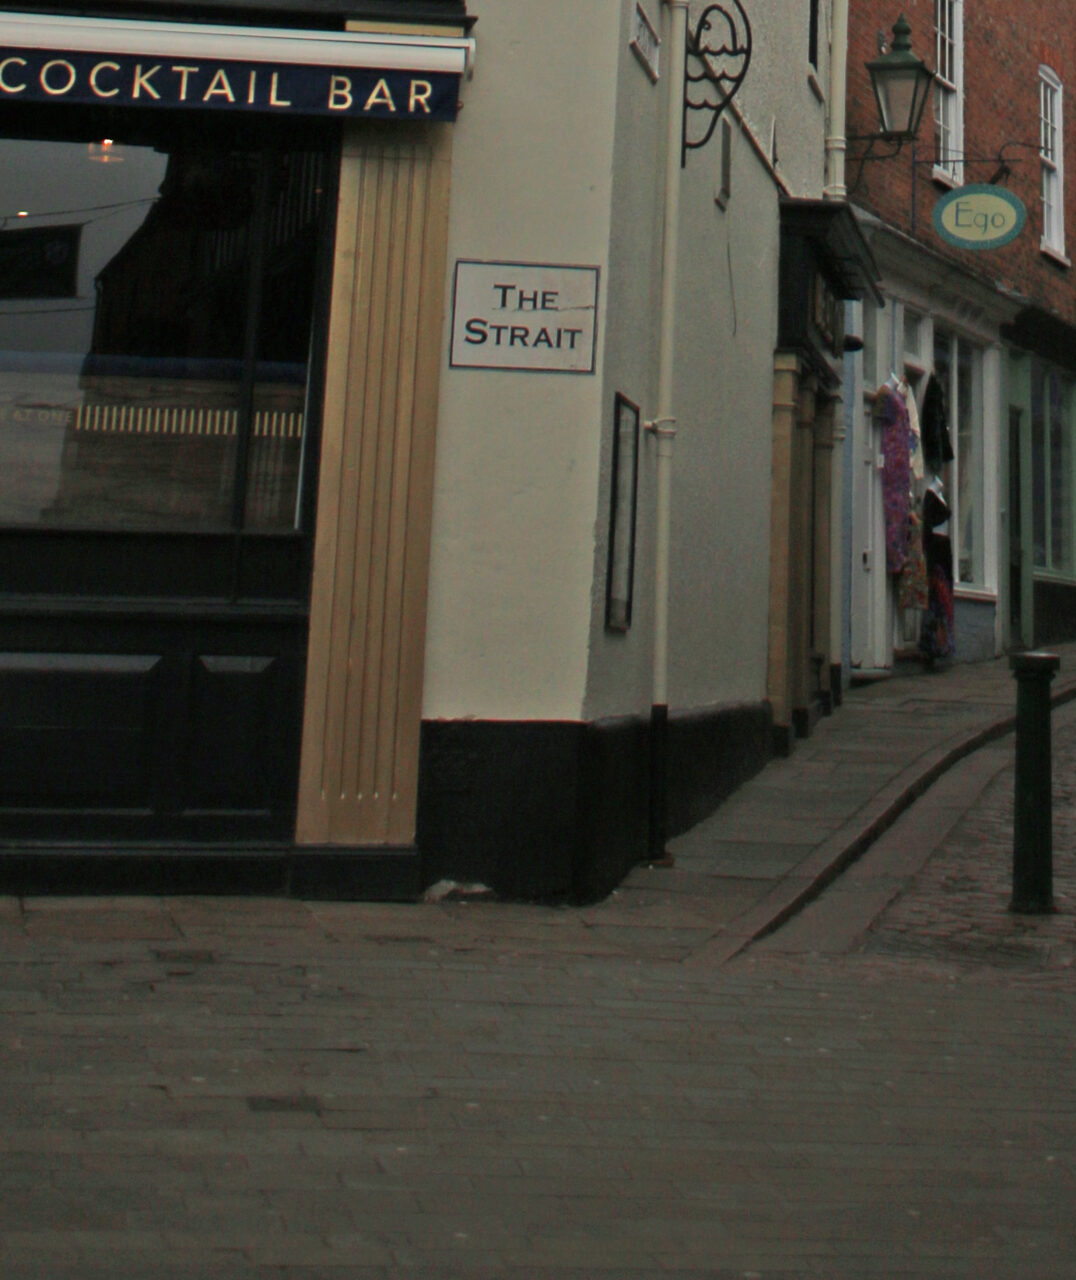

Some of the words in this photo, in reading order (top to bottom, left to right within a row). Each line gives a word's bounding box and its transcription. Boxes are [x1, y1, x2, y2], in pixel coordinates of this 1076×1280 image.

[0, 57, 291, 107] COCKTAIL
[327, 74, 432, 113] BAR
[955, 201, 1006, 235] Ego
[493, 284, 559, 311] THE
[464, 318, 583, 349] STRAIT
